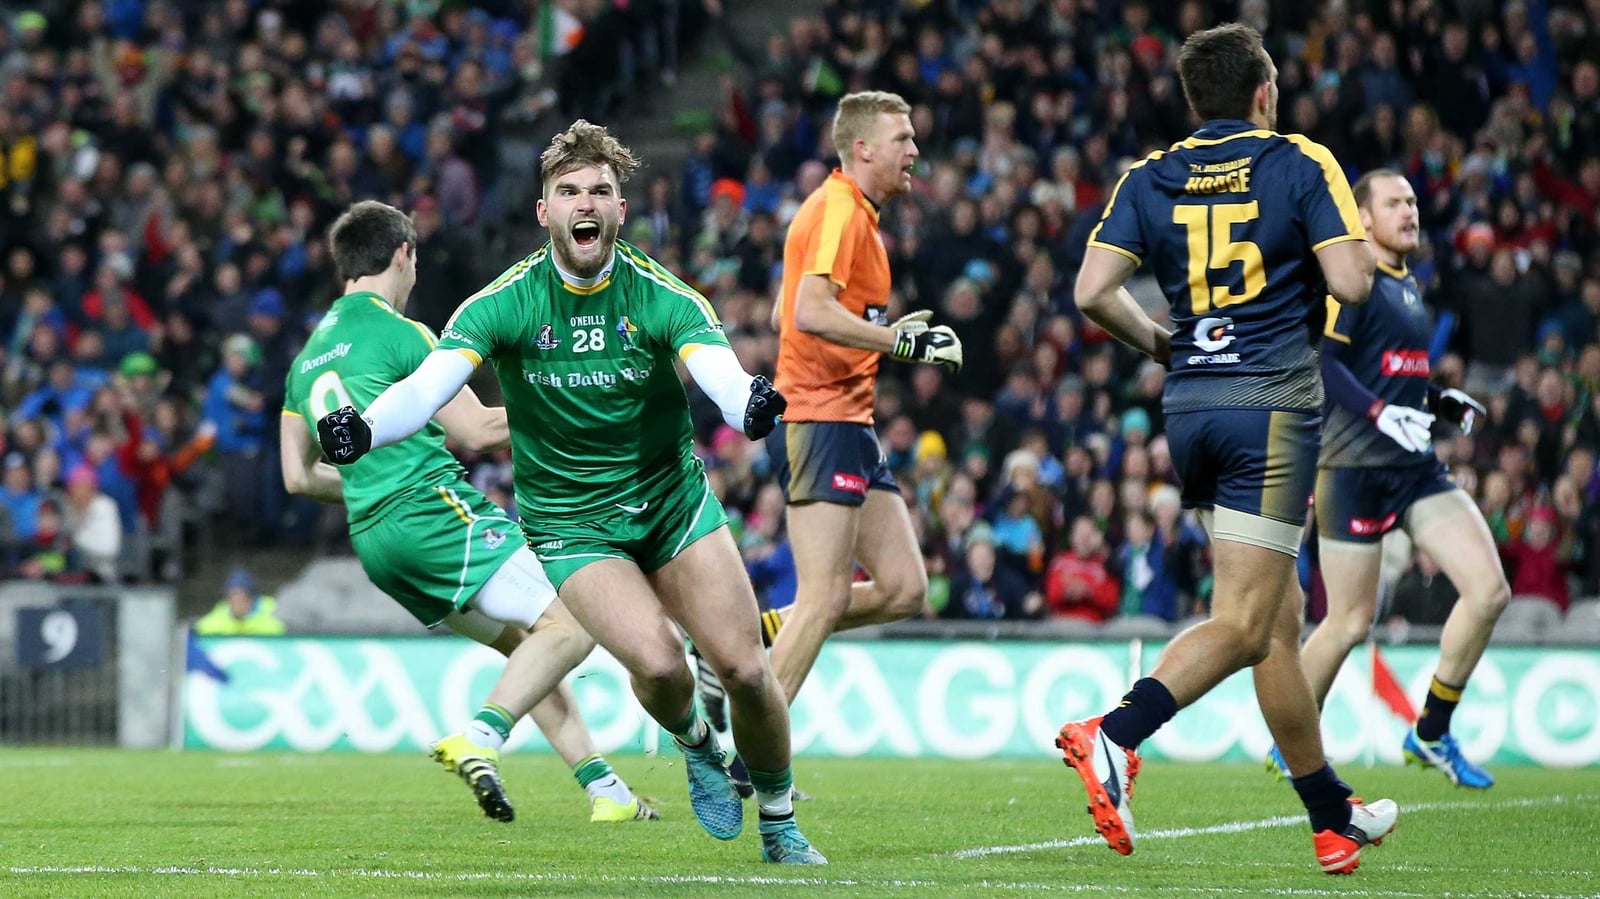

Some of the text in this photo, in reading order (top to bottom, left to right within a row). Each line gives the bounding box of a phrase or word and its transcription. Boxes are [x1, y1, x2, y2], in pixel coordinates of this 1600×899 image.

[1184, 168, 1251, 195] HODGE
[1173, 200, 1267, 315] 15
[570, 315, 606, 328] O'NEILLS
[572, 328, 606, 353] 28
[301, 343, 352, 374] Donnelly
[522, 368, 563, 388] Irish
[567, 371, 617, 388] Daily
[40, 611, 79, 664] 9
